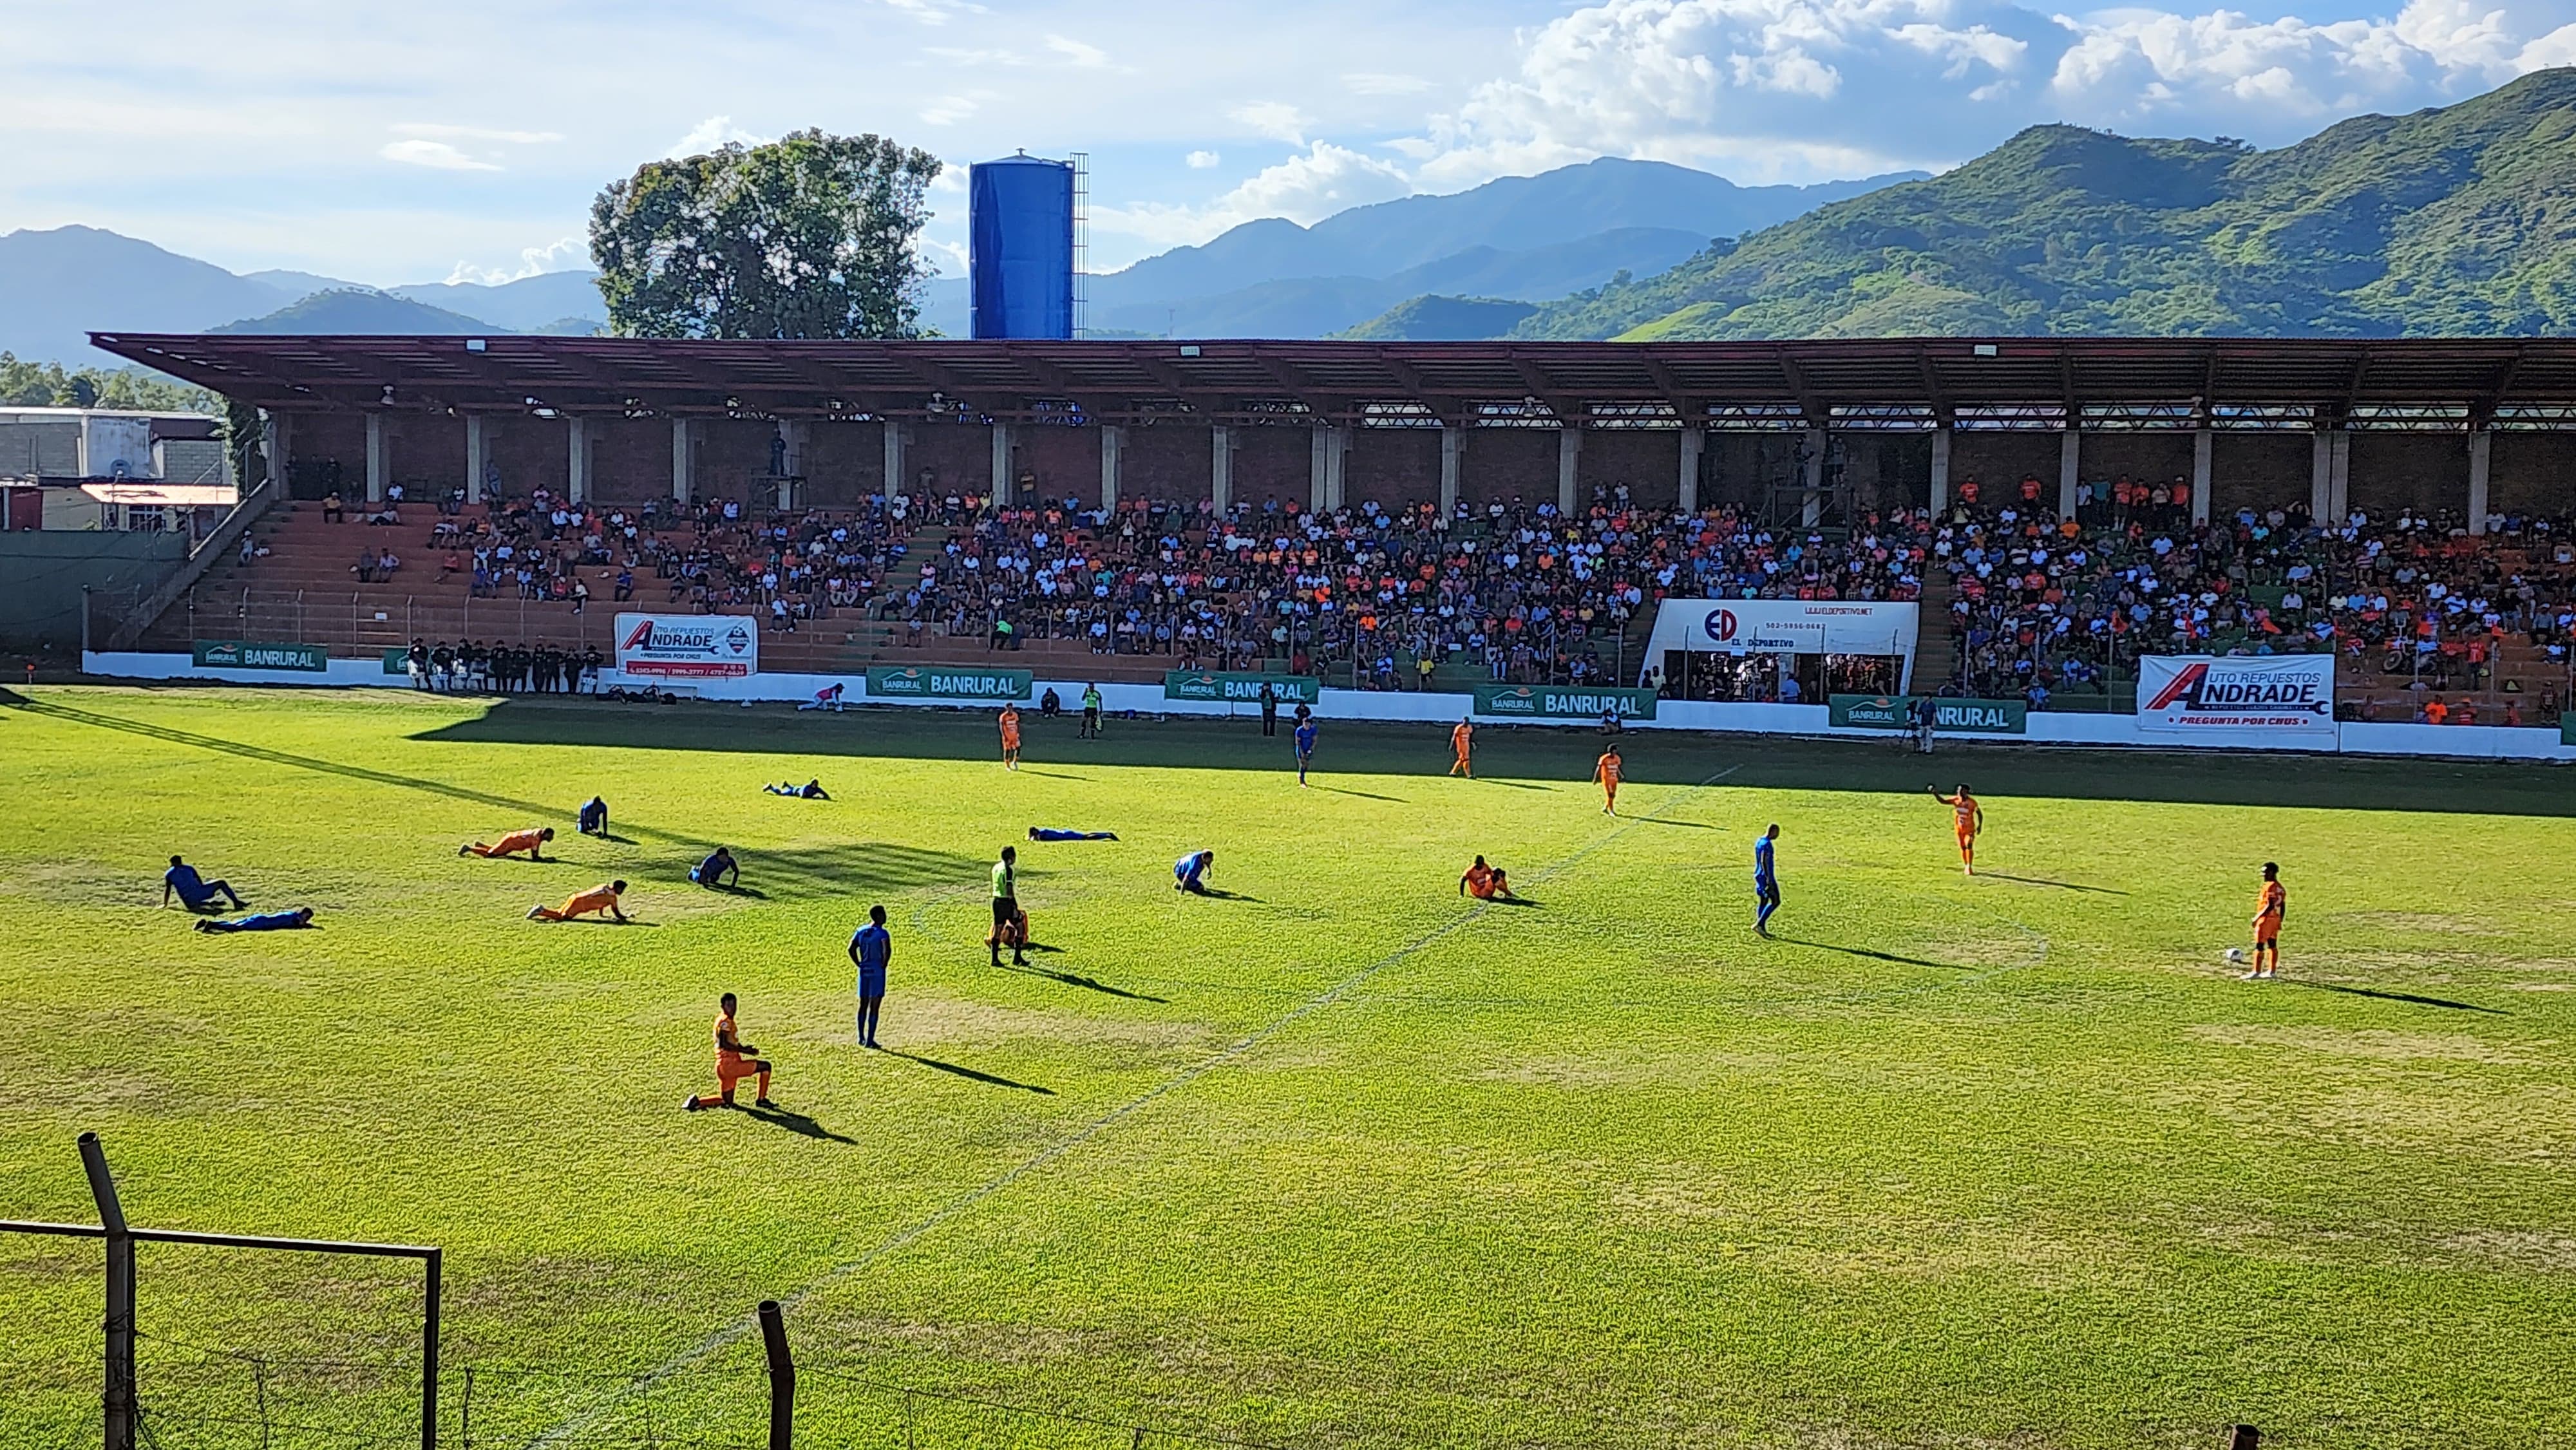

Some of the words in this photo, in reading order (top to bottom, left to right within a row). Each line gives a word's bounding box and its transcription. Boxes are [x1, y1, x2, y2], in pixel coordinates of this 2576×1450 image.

[1705, 609, 1738, 642] ED
[621, 620, 712, 650] ANDRADE
[1747, 639, 1794, 648] DEPORTIVO
[244, 649, 316, 668] BANRURAL
[882, 680, 922, 690] BANRURAL
[931, 675, 1018, 695] BANRURAL
[2240, 672, 2322, 683] REPUESTOS
[2144, 664, 2318, 711] ANDRADE
[1492, 699, 1535, 709] BANRURAL
[1545, 694, 1642, 715] BANRURAL
[1848, 710, 1895, 720] BANRURAL
[2240, 717, 2266, 725] POR
